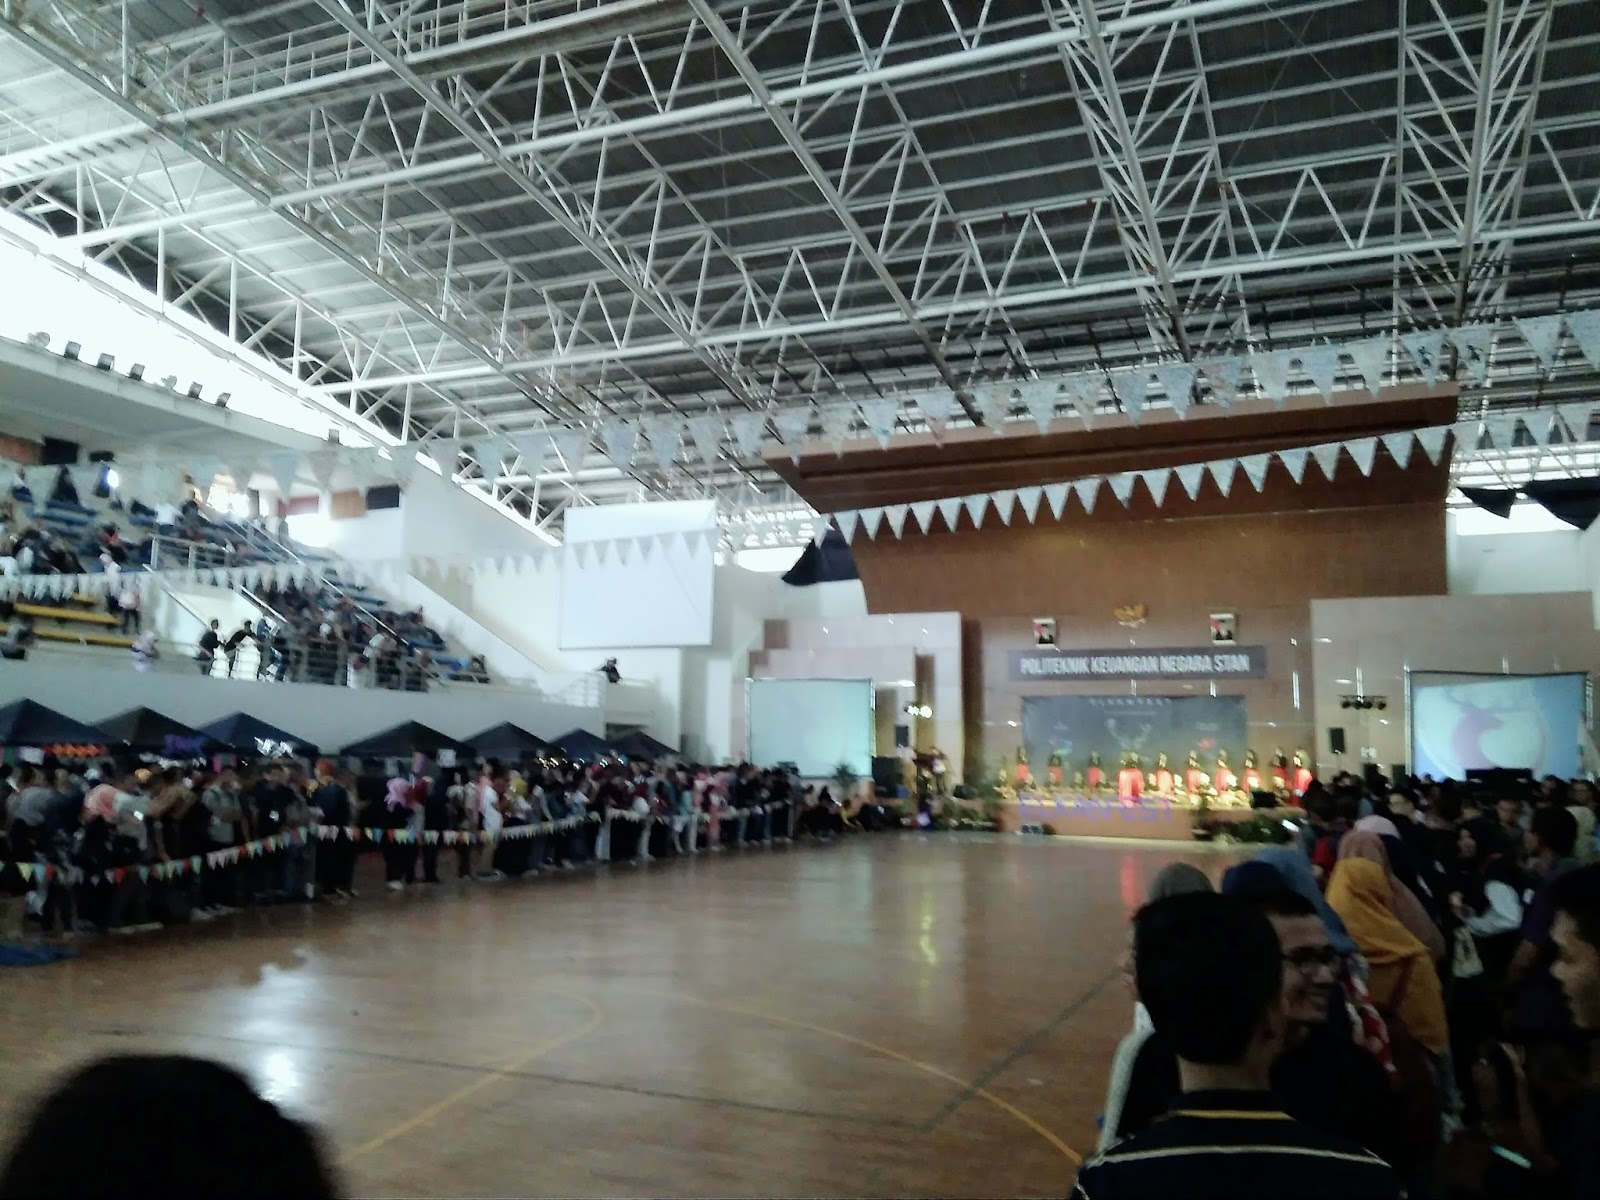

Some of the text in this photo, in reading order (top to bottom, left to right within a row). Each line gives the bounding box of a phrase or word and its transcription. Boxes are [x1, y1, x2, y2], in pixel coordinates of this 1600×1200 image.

[1020, 654, 1250, 674] POLITEKNIK KEUANGAN NEGARA STAN
